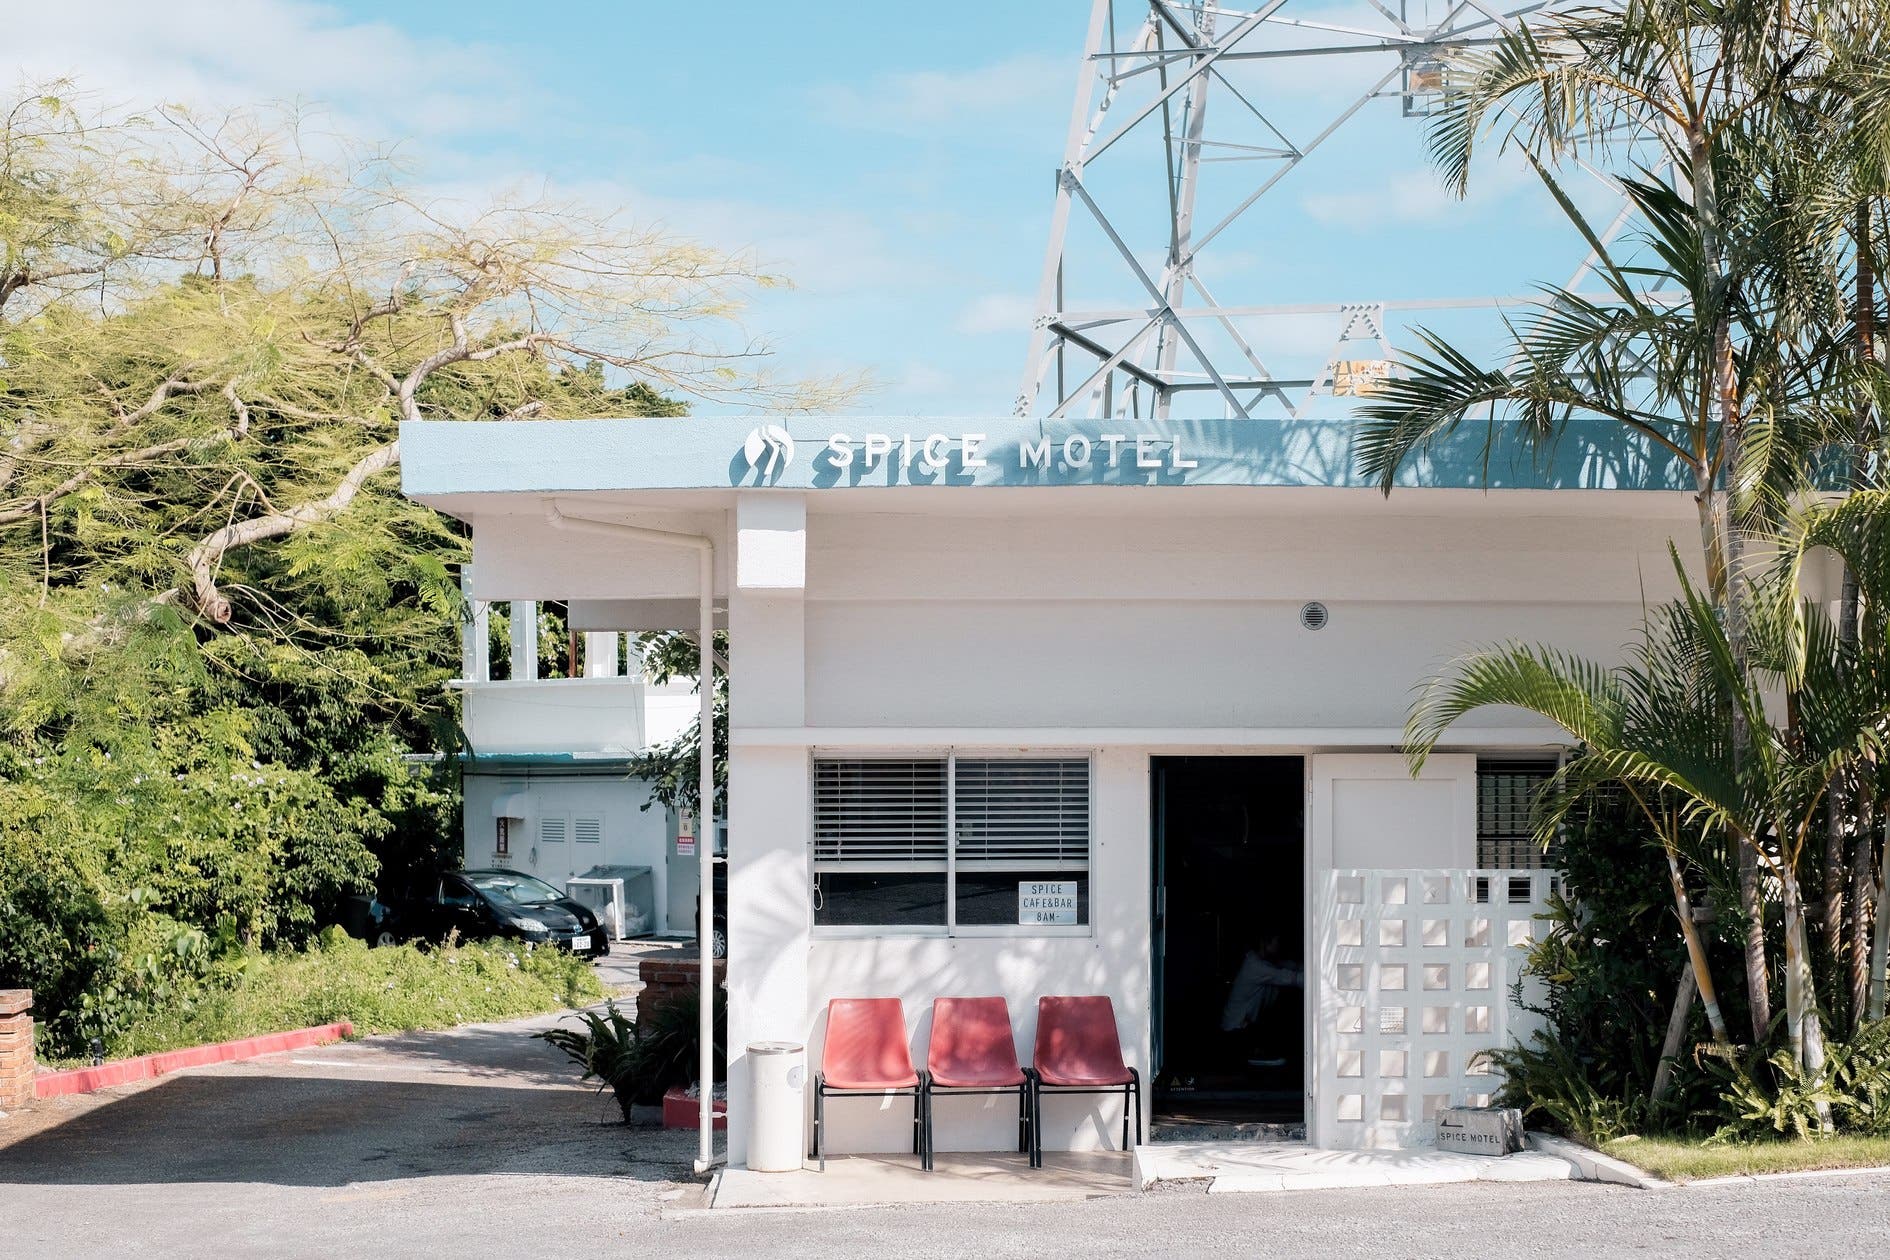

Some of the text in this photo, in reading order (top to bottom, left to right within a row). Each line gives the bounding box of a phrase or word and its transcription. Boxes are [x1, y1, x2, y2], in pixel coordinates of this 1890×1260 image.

[828, 433, 1199, 469] SPICE MOTEL
[1032, 885, 1063, 894] SPICE
[1024, 898, 1072, 908] CAFE&BAR
[1441, 1133, 1500, 1143] SPICE MOTEL
